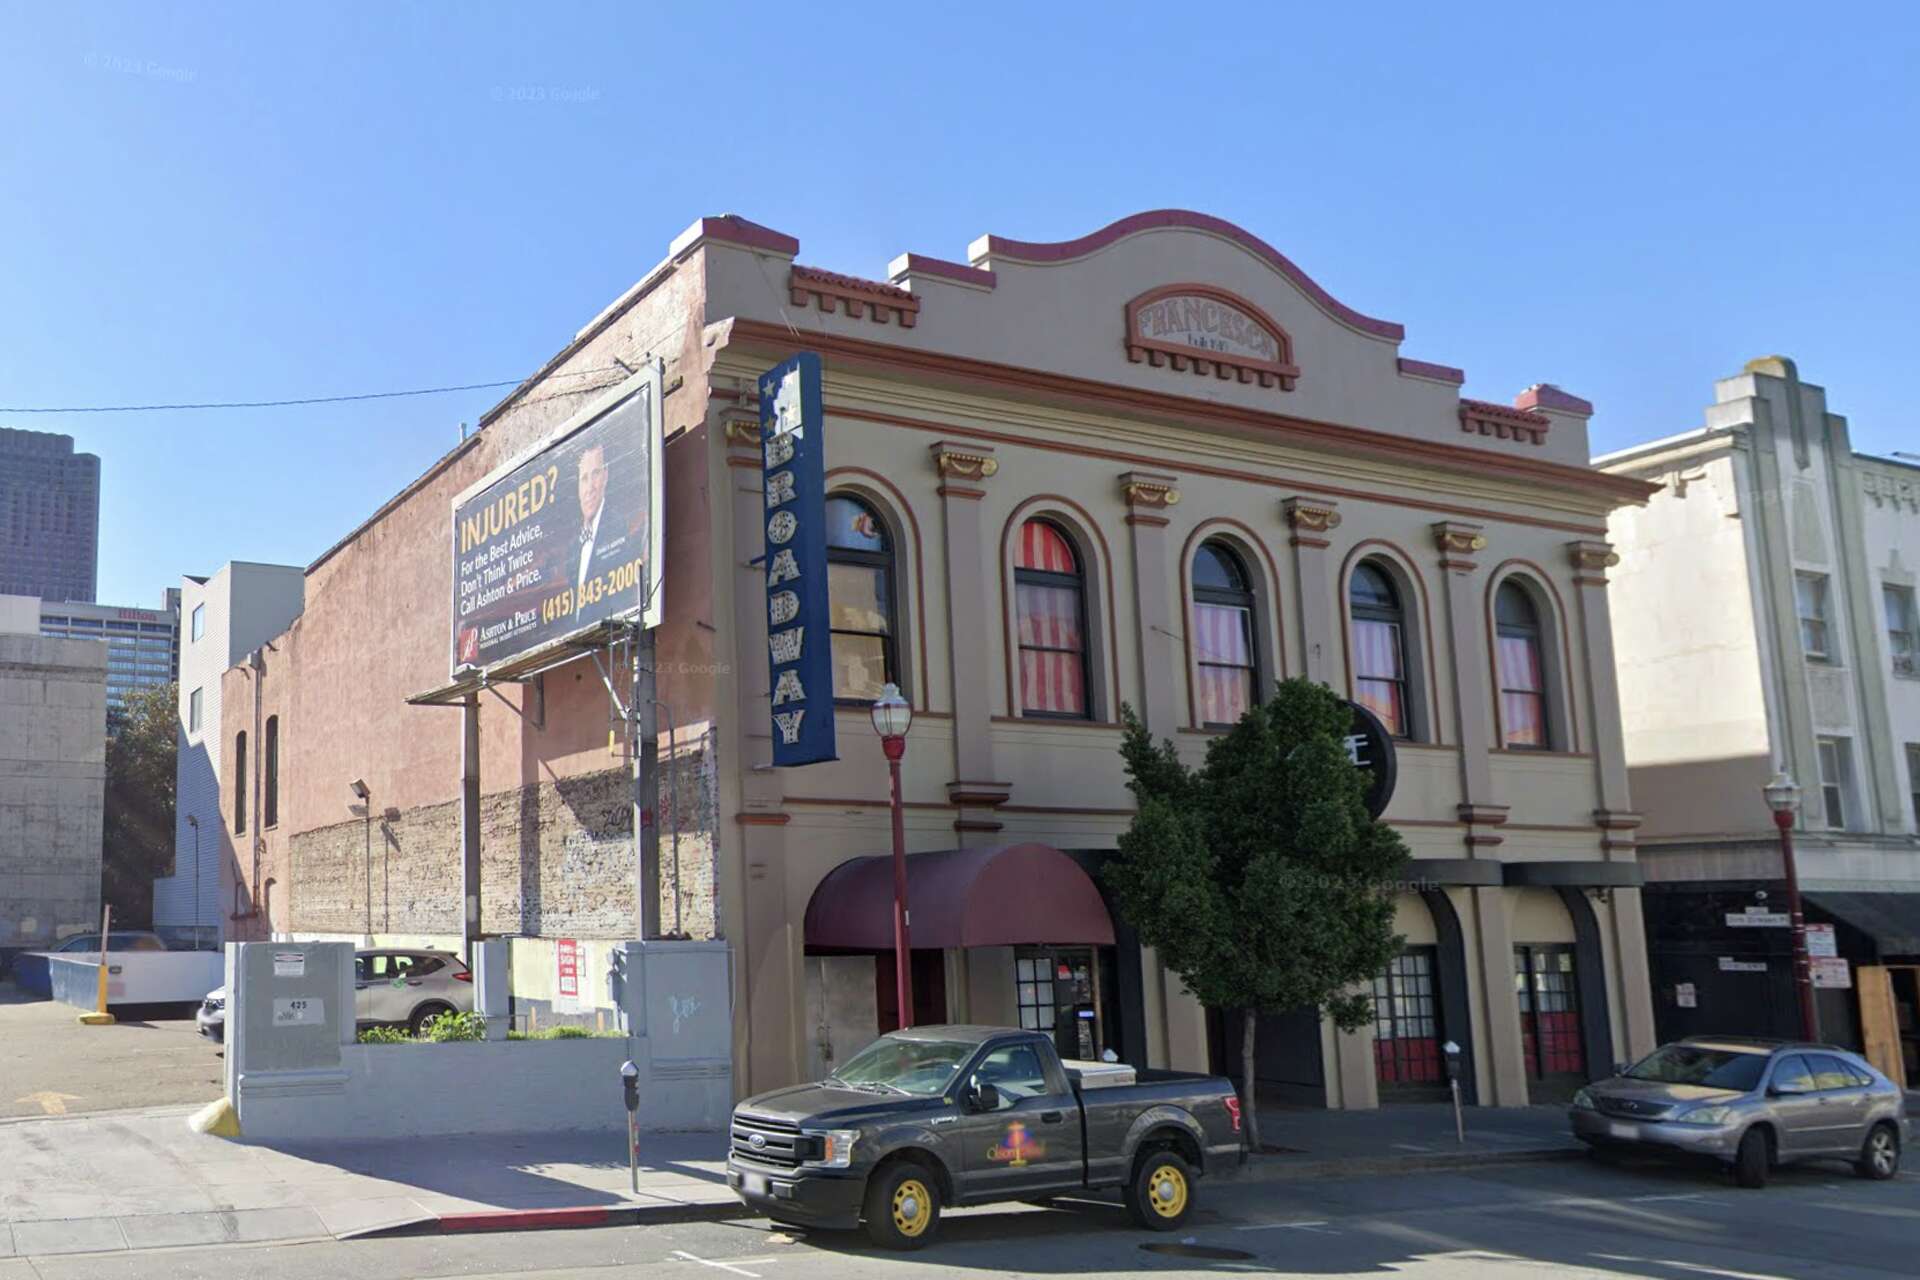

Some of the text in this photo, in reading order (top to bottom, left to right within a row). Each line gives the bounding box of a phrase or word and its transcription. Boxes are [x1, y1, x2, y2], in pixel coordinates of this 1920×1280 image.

[461, 465, 558, 555] INJURED?
[461, 525, 543, 577] For the Best Advice,
[461, 550, 533, 596] Don't Think Twice
[461, 569, 541, 616] Call Ashton & Price.
[542, 587, 574, 624] (415)
[766, 430, 807, 744] BROADWAY
